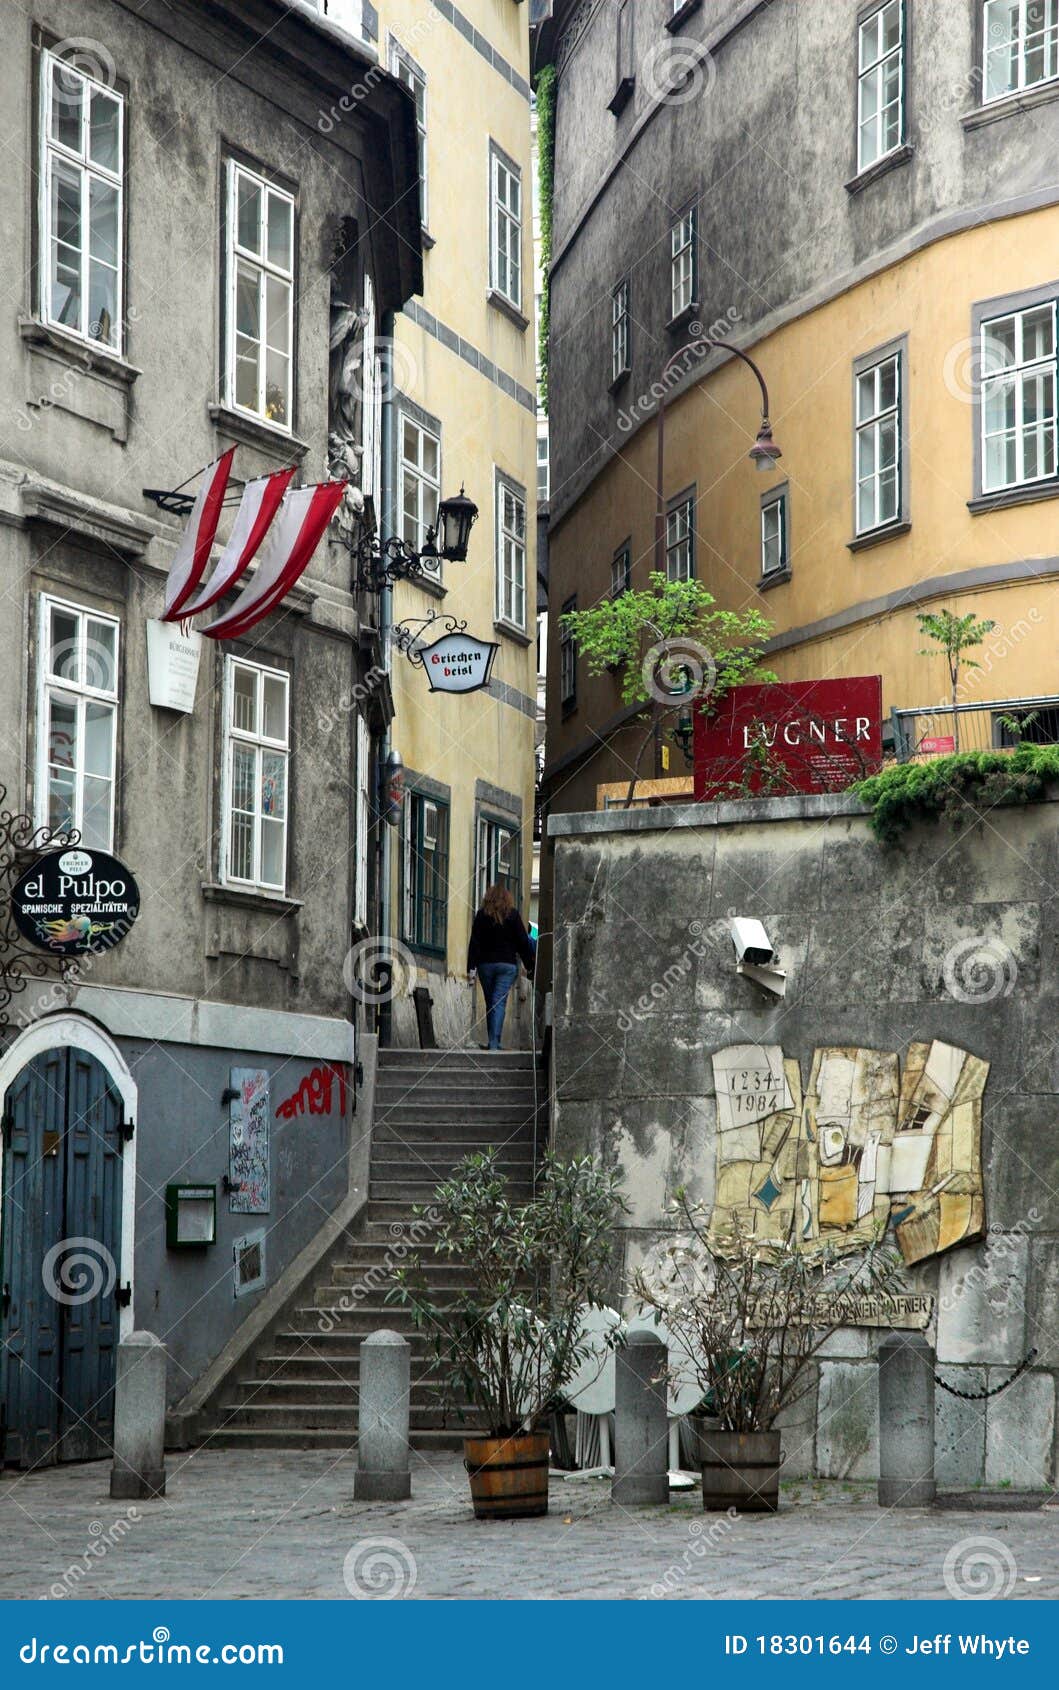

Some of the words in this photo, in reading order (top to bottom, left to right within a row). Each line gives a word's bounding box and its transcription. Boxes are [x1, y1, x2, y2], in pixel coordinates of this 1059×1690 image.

[431, 651, 482, 665] Griechen
[444, 665, 472, 677] beisl
[743, 717, 871, 749] LUGNER
[24, 875, 44, 897] el
[58, 873, 126, 903] Pulpo
[21, 904, 63, 914] SPANISCHE
[70, 901, 128, 913] SPEZIALITÄTEN
[736, 1094, 777, 1112] 1984
